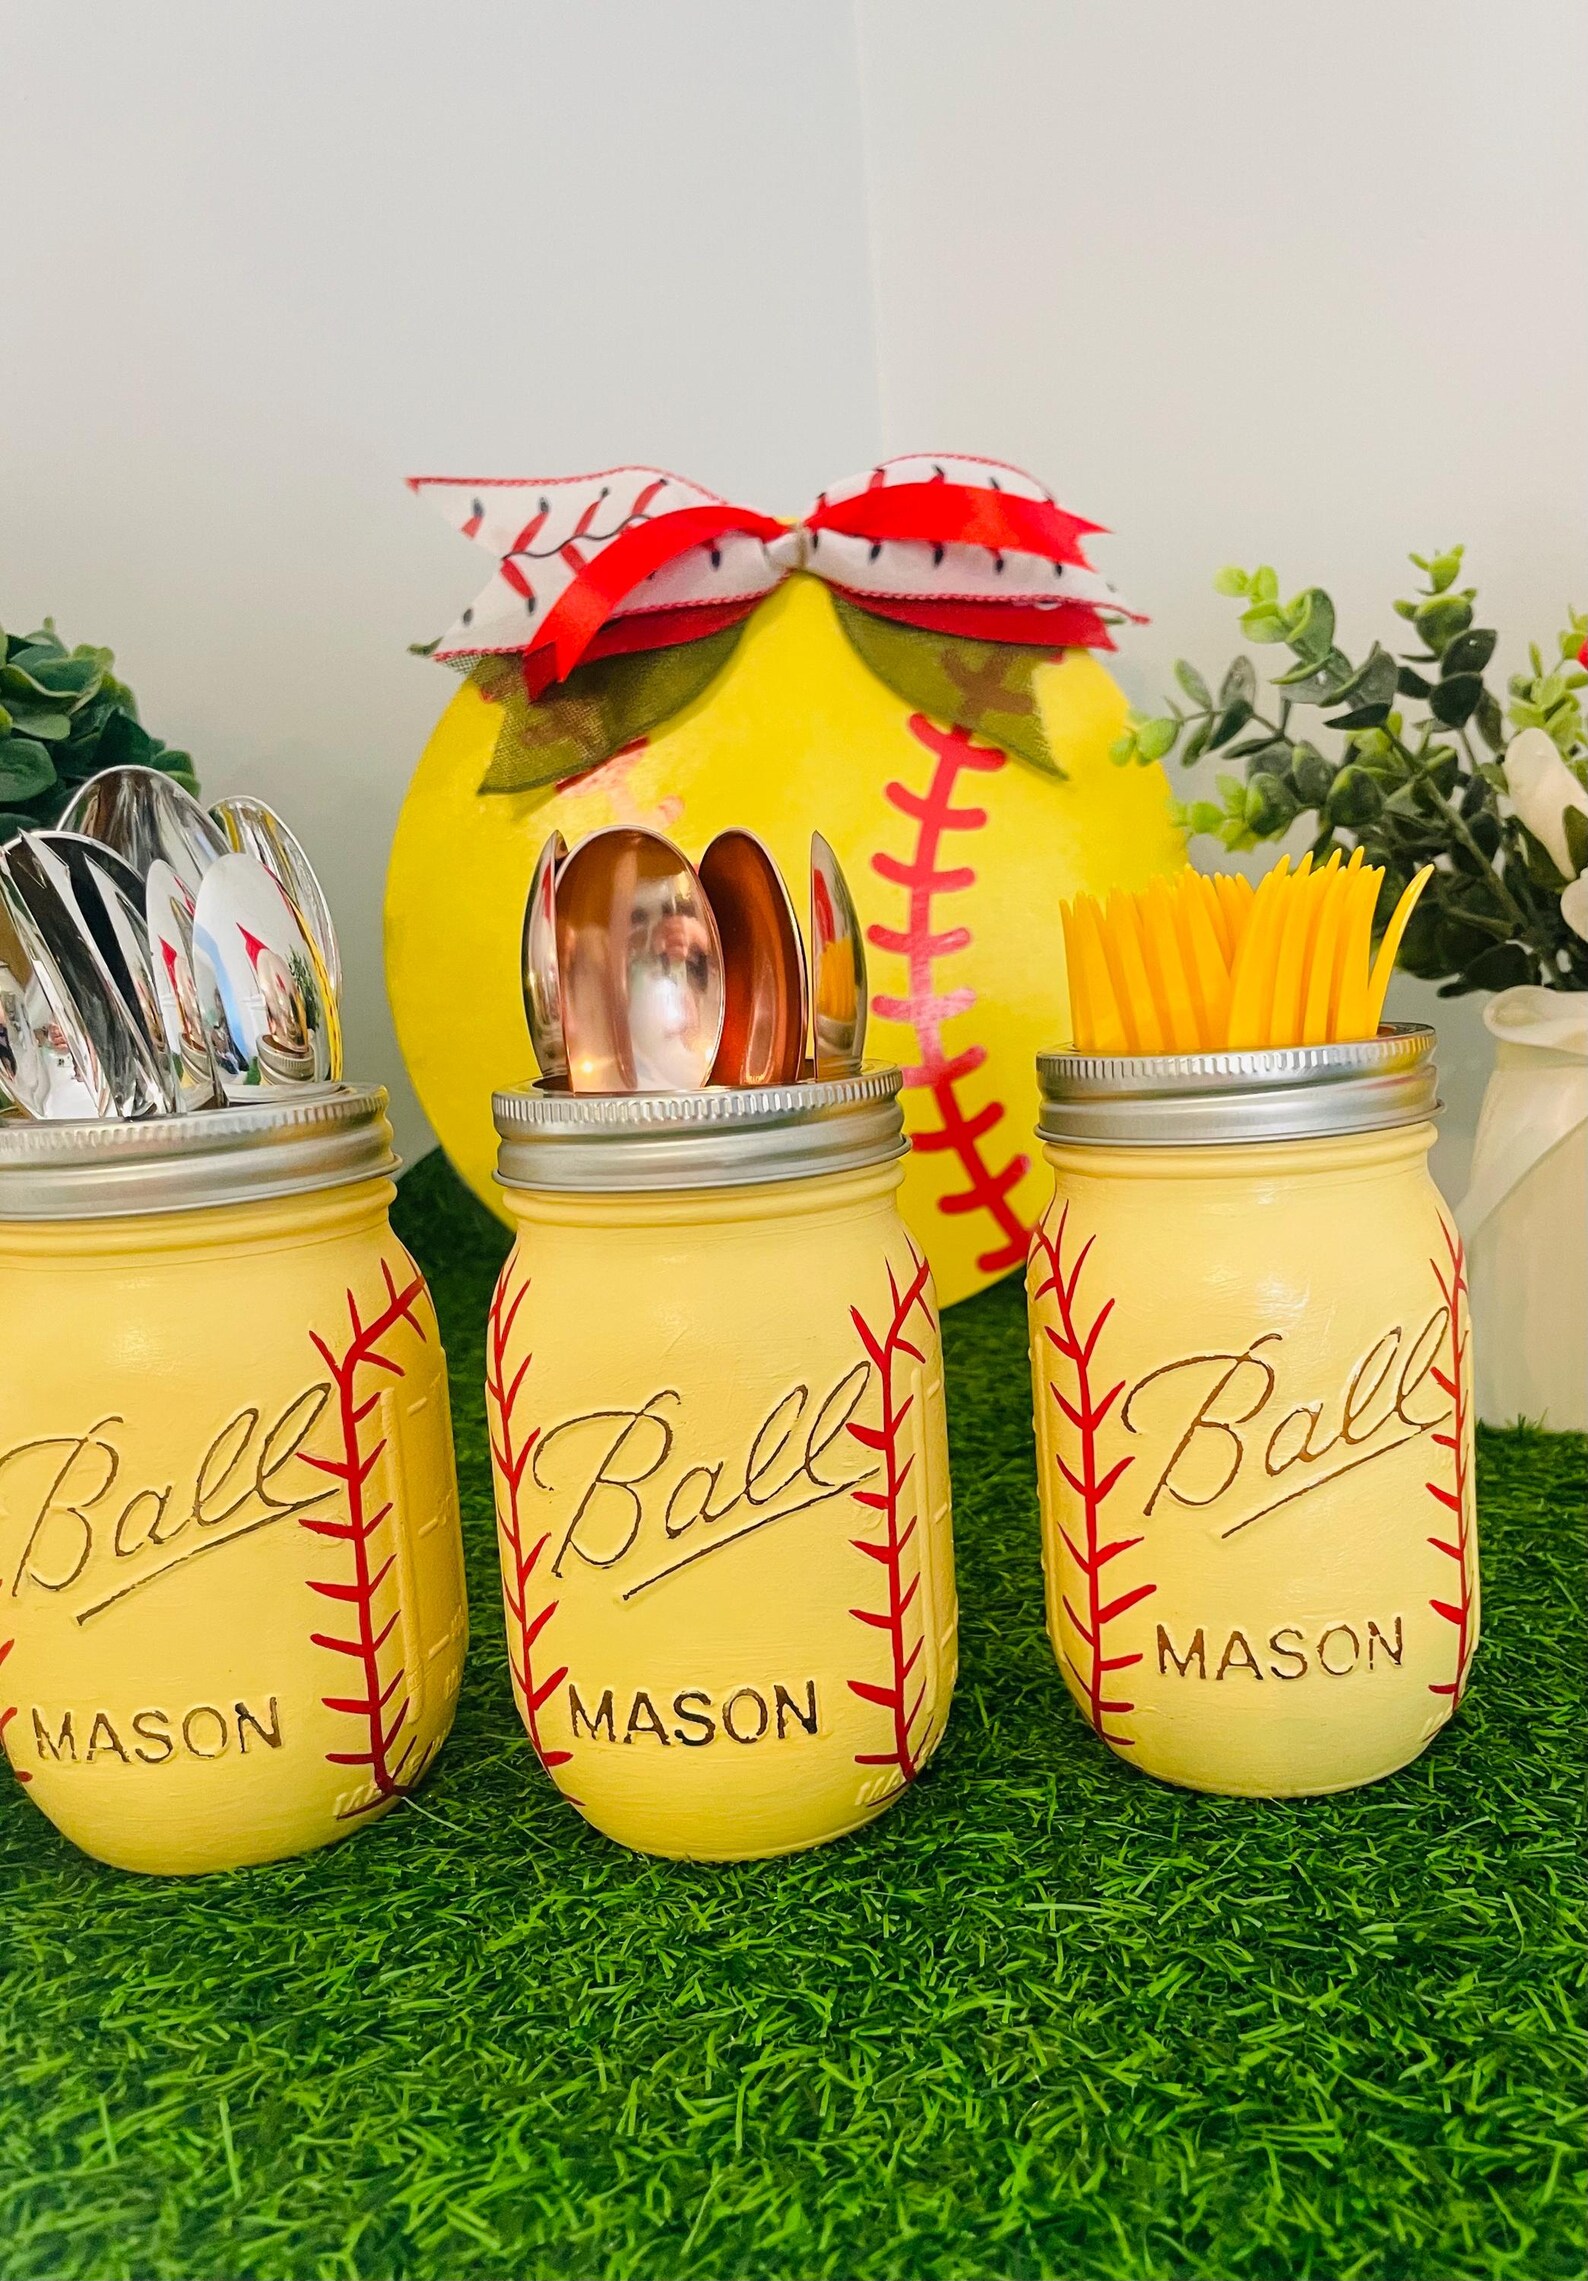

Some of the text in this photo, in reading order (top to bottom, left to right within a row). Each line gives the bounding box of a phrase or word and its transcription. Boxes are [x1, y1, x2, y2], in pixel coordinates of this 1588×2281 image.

[532, 1361, 880, 1579] Ball
[1121, 1306, 1453, 1517] Ball
[0, 1382, 341, 1598] Ball
[568, 1680, 818, 1747] MASON
[1155, 1616, 1402, 1681] MASON
[32, 1696, 282, 1764] MASON
